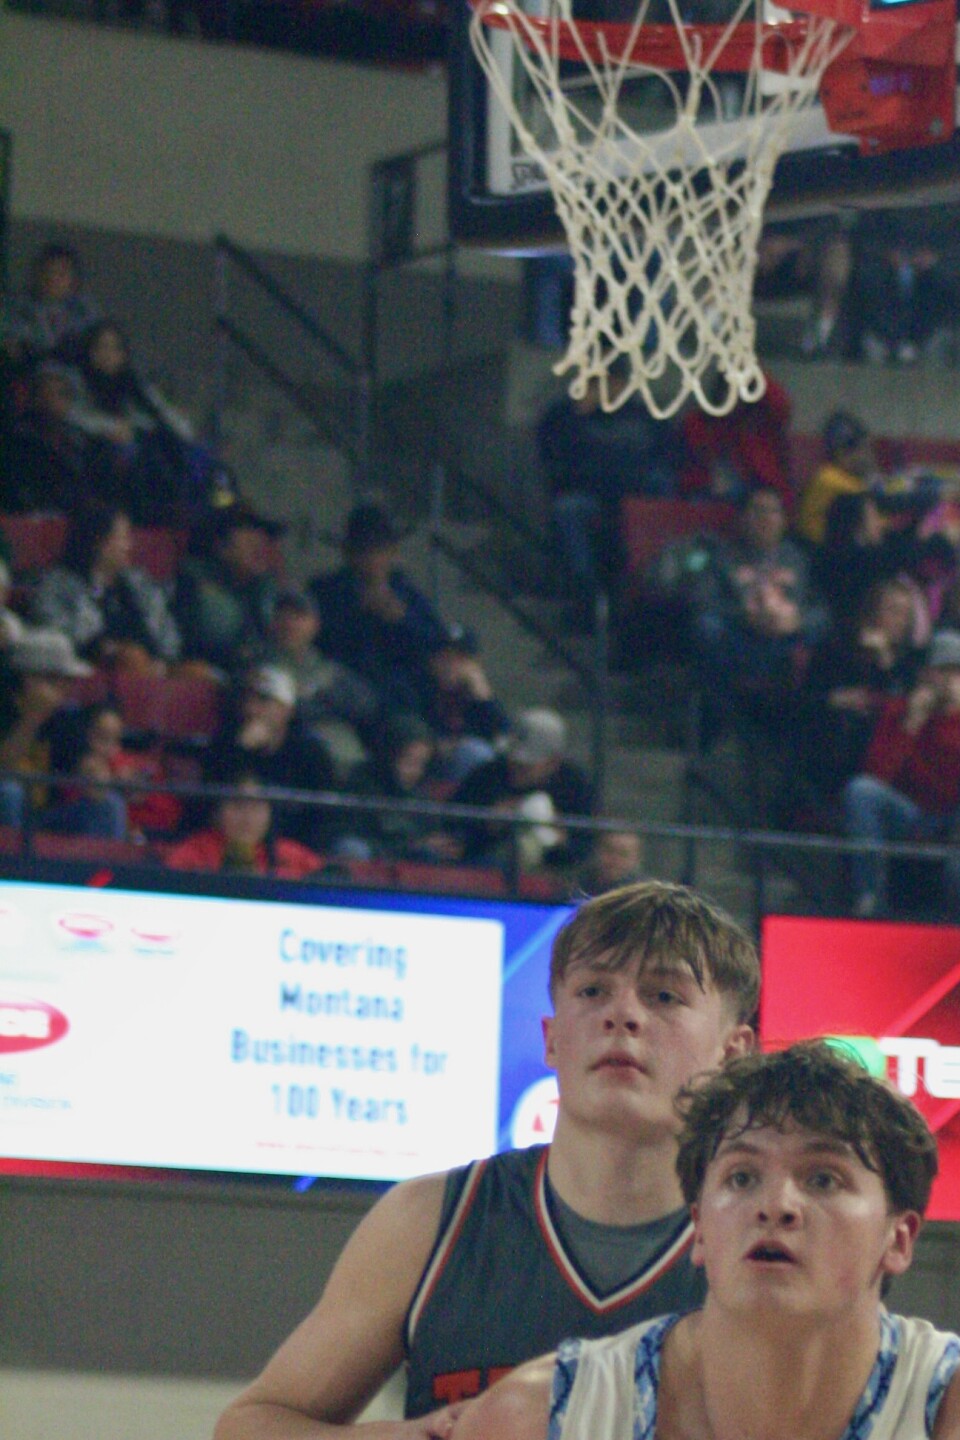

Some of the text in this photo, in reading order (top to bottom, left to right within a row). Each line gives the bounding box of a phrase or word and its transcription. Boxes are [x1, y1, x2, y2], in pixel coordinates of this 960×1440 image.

[280, 927, 406, 979] Covering
[280, 981, 404, 1022] Montana
[231, 1028, 447, 1076] Businesses for
[271, 1083, 407, 1126] 100 Years
